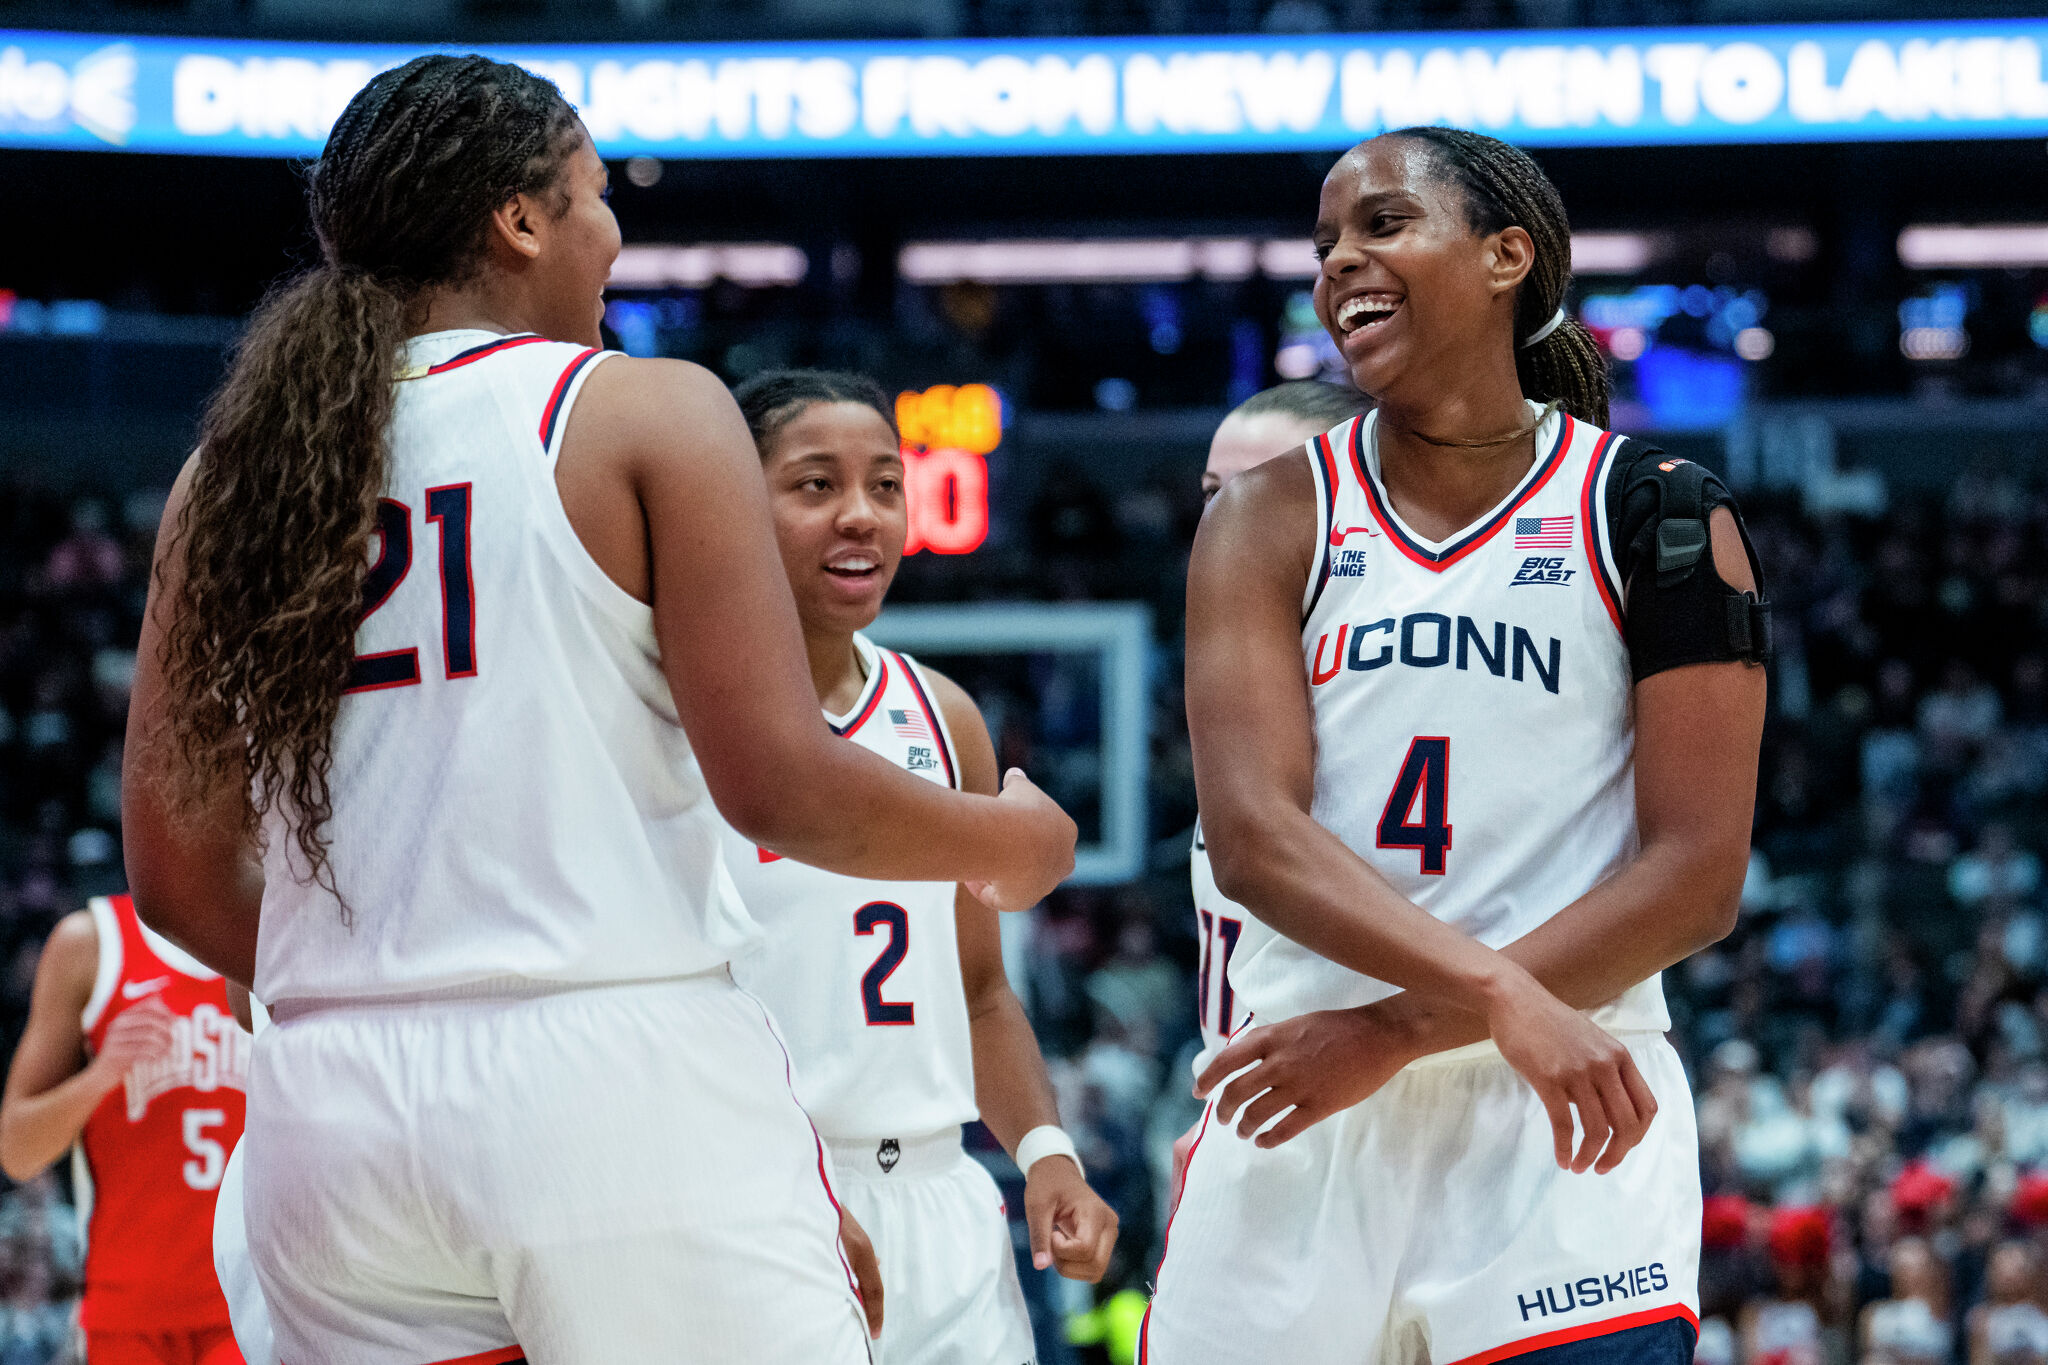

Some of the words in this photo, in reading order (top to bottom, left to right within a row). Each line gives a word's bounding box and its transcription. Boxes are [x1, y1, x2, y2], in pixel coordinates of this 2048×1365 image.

[861, 54, 1116, 138] FROM
[1122, 50, 1335, 135] NEW
[1341, 46, 1643, 131] HAVEN
[1645, 41, 1785, 125] TO
[1330, 563, 1367, 577] ANGE
[1341, 550, 1367, 563] THE
[1514, 569, 1576, 581] EAST
[1521, 557, 1565, 569] BIG
[343, 481, 478, 695] 21
[1311, 612, 1561, 694] UCONN
[907, 757, 938, 769] EAST
[909, 746, 931, 758] BIG
[1376, 736, 1452, 875] 4
[854, 901, 915, 1026] 2
[182, 1108, 226, 1190] 5
[1517, 1262, 1669, 1322] HUSKIES
